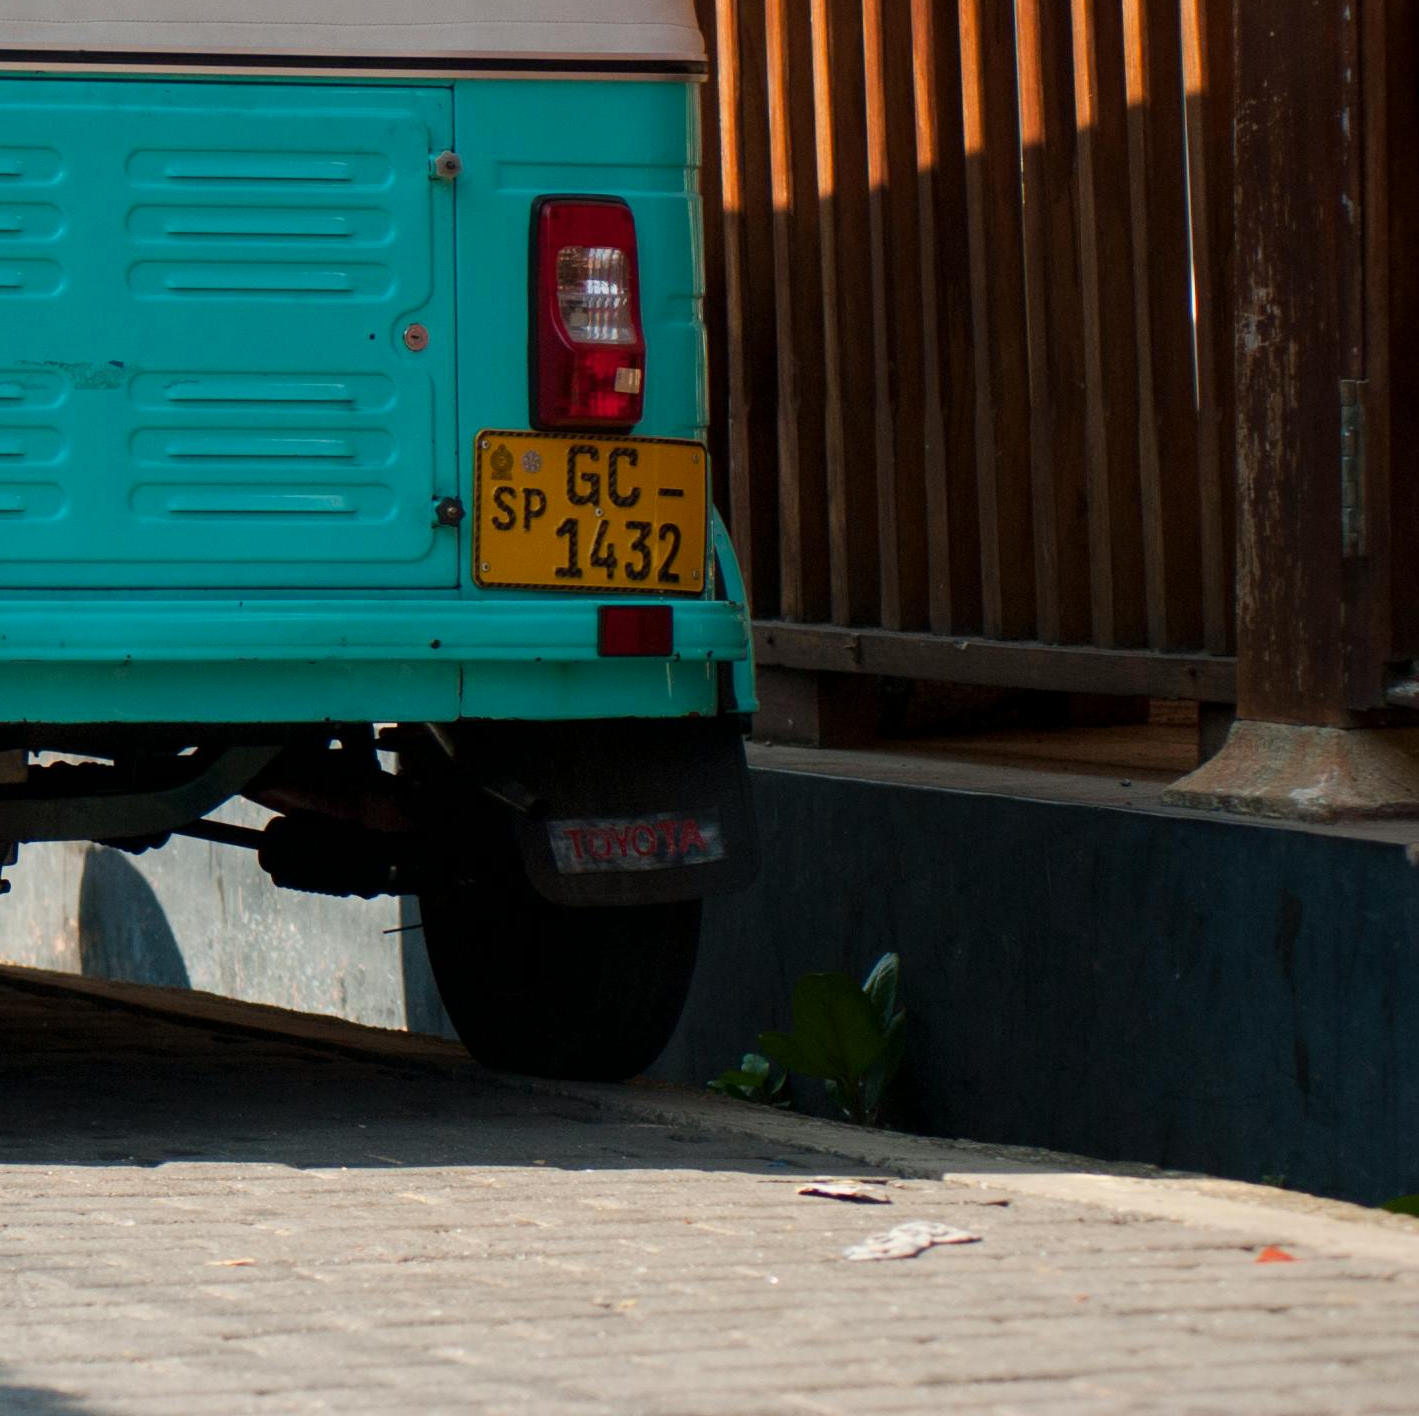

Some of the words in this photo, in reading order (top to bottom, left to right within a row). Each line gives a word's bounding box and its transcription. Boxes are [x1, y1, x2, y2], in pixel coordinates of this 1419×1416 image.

[491, 486, 547, 531] SP
[554, 517, 683, 584] 1432
[563, 818, 708, 861] TOYOTA
